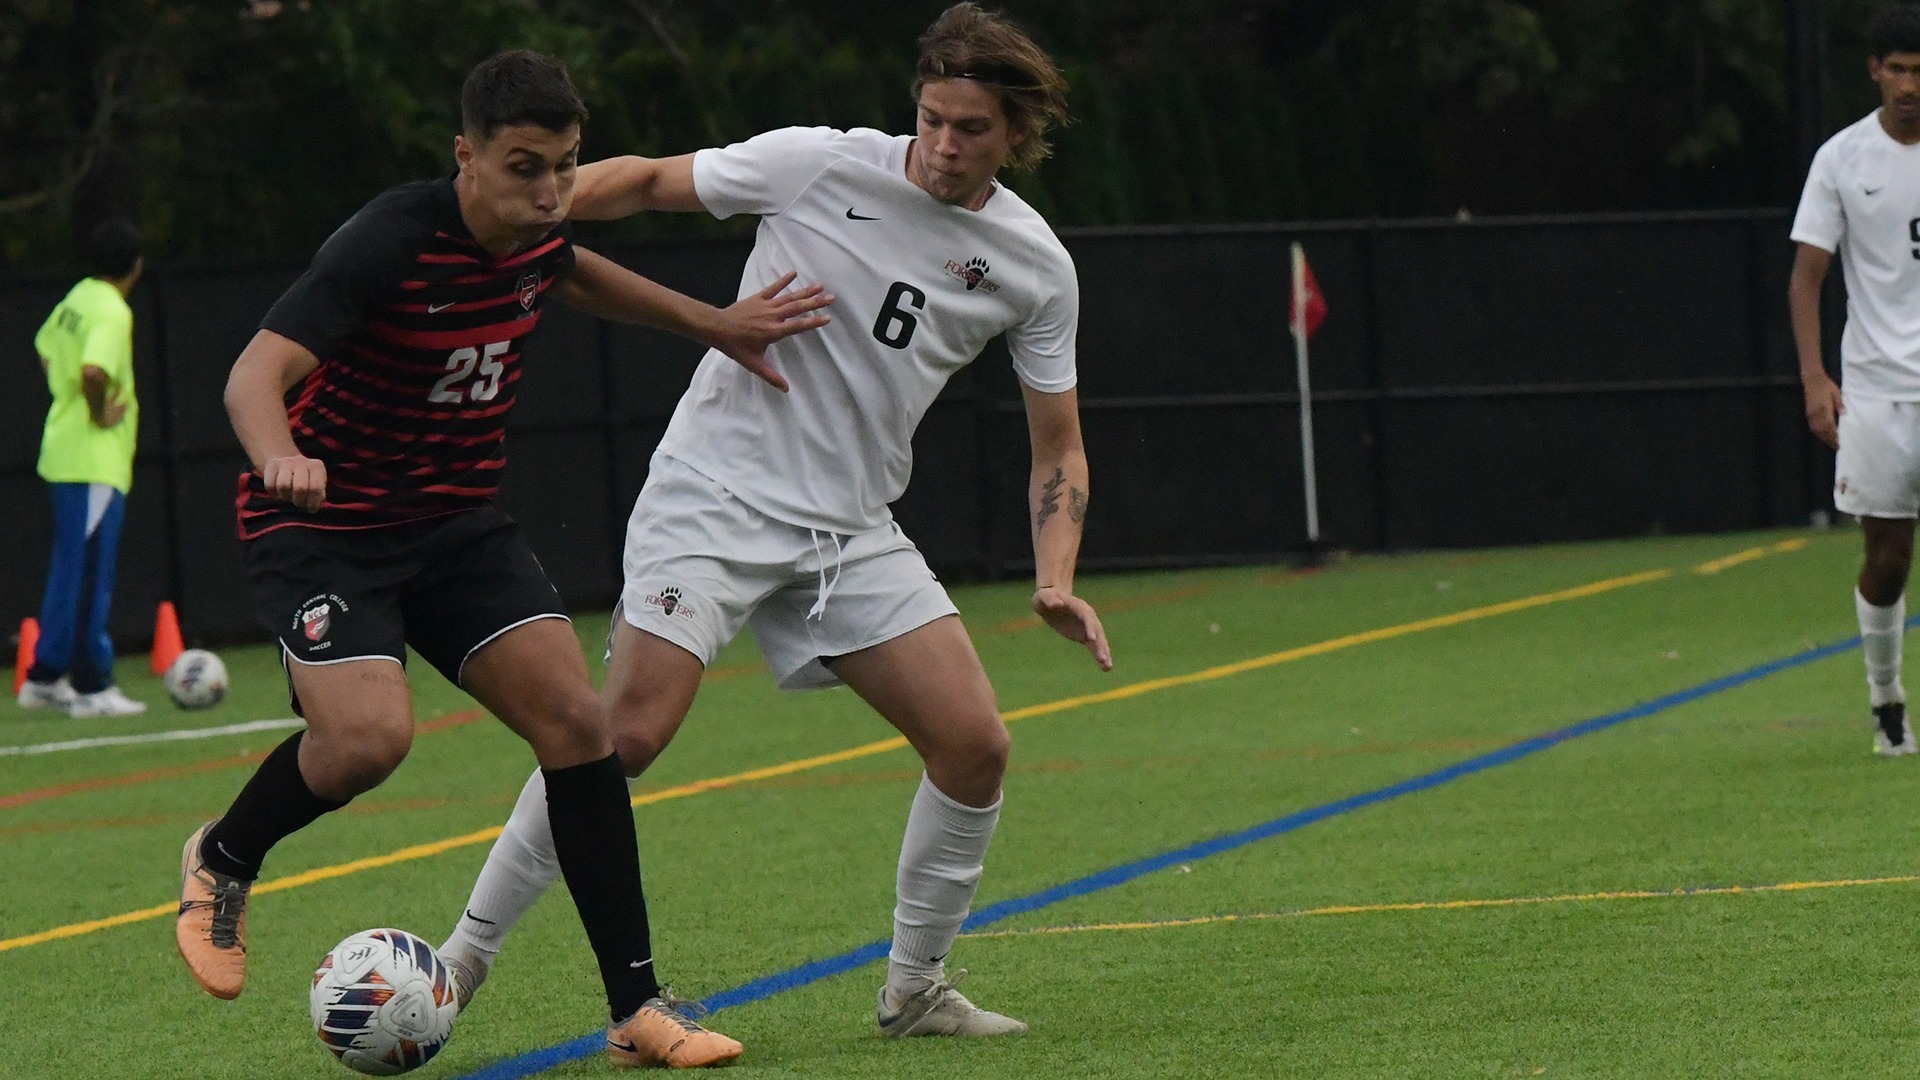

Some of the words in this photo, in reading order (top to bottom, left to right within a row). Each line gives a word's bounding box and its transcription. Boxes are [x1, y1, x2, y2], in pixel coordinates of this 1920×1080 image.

[872, 281, 926, 349] 6
[427, 340, 511, 404] 25
[302, 593, 327, 609] CENTRAL
[329, 593, 350, 613] COLLEGE
[307, 608, 325, 621] NCC
